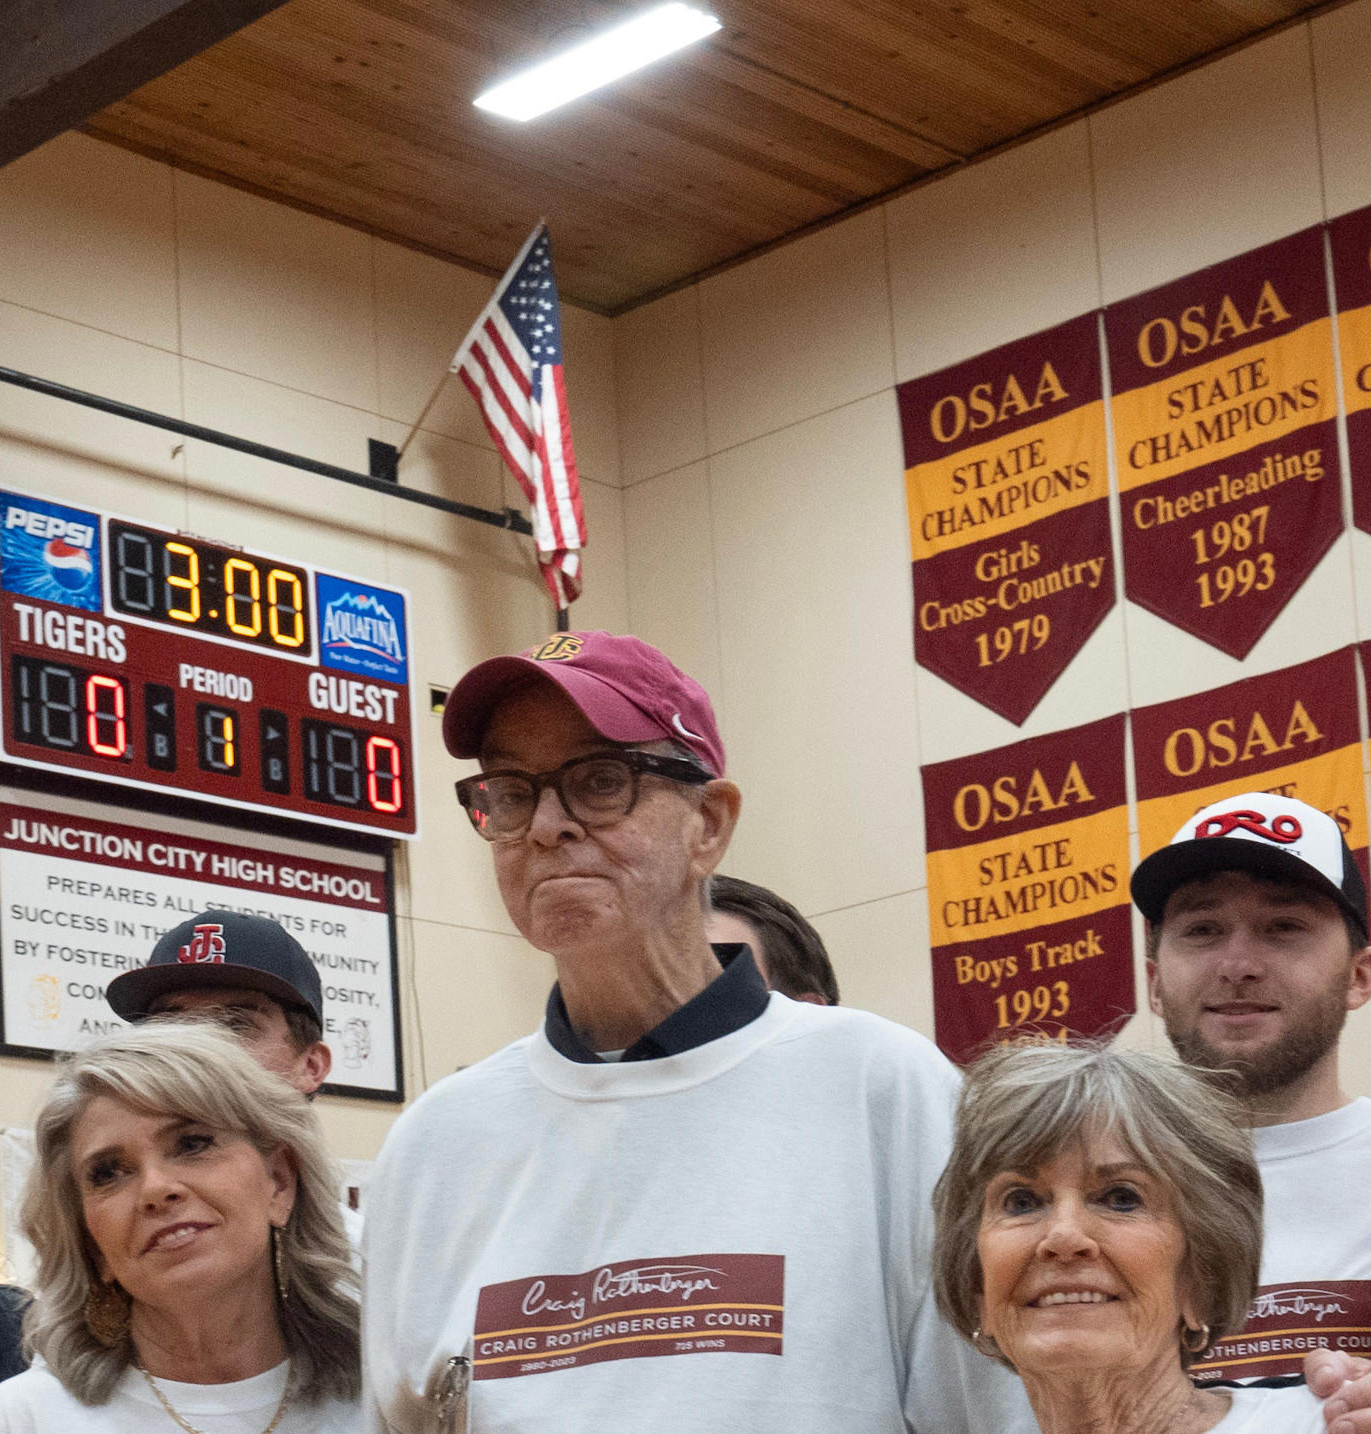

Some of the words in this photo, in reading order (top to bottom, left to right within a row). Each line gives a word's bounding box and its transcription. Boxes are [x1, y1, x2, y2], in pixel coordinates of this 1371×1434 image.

[1137, 280, 1292, 368] OSAA
[931, 361, 1069, 443] OSAA
[1168, 358, 1269, 420] STATE
[1128, 379, 1319, 470] CHAMPIONS
[952, 439, 1047, 494] STATE
[1133, 449, 1325, 530] Cheerleading
[5, 506, 94, 549] PEPSI
[922, 461, 1090, 541] CHAMPIONS
[975, 541, 1041, 582] Girls
[1191, 505, 1270, 564] 1987
[920, 557, 1105, 631] Cross-Country
[1196, 552, 1276, 608] 1993
[13, 603, 127, 663] TIGERS
[975, 614, 1050, 667] 1979
[179, 663, 253, 702] PERIOD
[308, 673, 399, 724] GUEST
[1164, 700, 1324, 777] OSAA
[953, 759, 1096, 832] OSAA
[4, 818, 143, 861] JUNCTION
[147, 843, 208, 872] CITY
[211, 854, 275, 885] HIGH
[279, 866, 381, 904] SCHOOL
[979, 838, 1073, 886] STATE
[47, 875, 158, 908] PREPARES
[163, 895, 200, 914] ALL
[310, 919, 348, 938] FOR
[942, 863, 1118, 928] CHAMPIONS
[10, 904, 109, 933] SUCCESS
[115, 920, 135, 938] IN
[309, 951, 381, 975] MUNITY
[954, 955, 1019, 988] Boys
[1025, 929, 1105, 972] Track
[14, 940, 39, 957] BY
[46, 944, 149, 970] FOSTERIN
[324, 986, 381, 1008] OSITY,
[995, 980, 1070, 1029] 1993
[521, 1280, 586, 1320] Craig
[480, 1337, 537, 1355] CRAIG
[546, 1315, 696, 1348] ROTHENBERGER
[704, 1313, 773, 1327] COURT
[695, 1339, 725, 1349] WINS
[1203, 1337, 1329, 1359] OTHENBERGER
